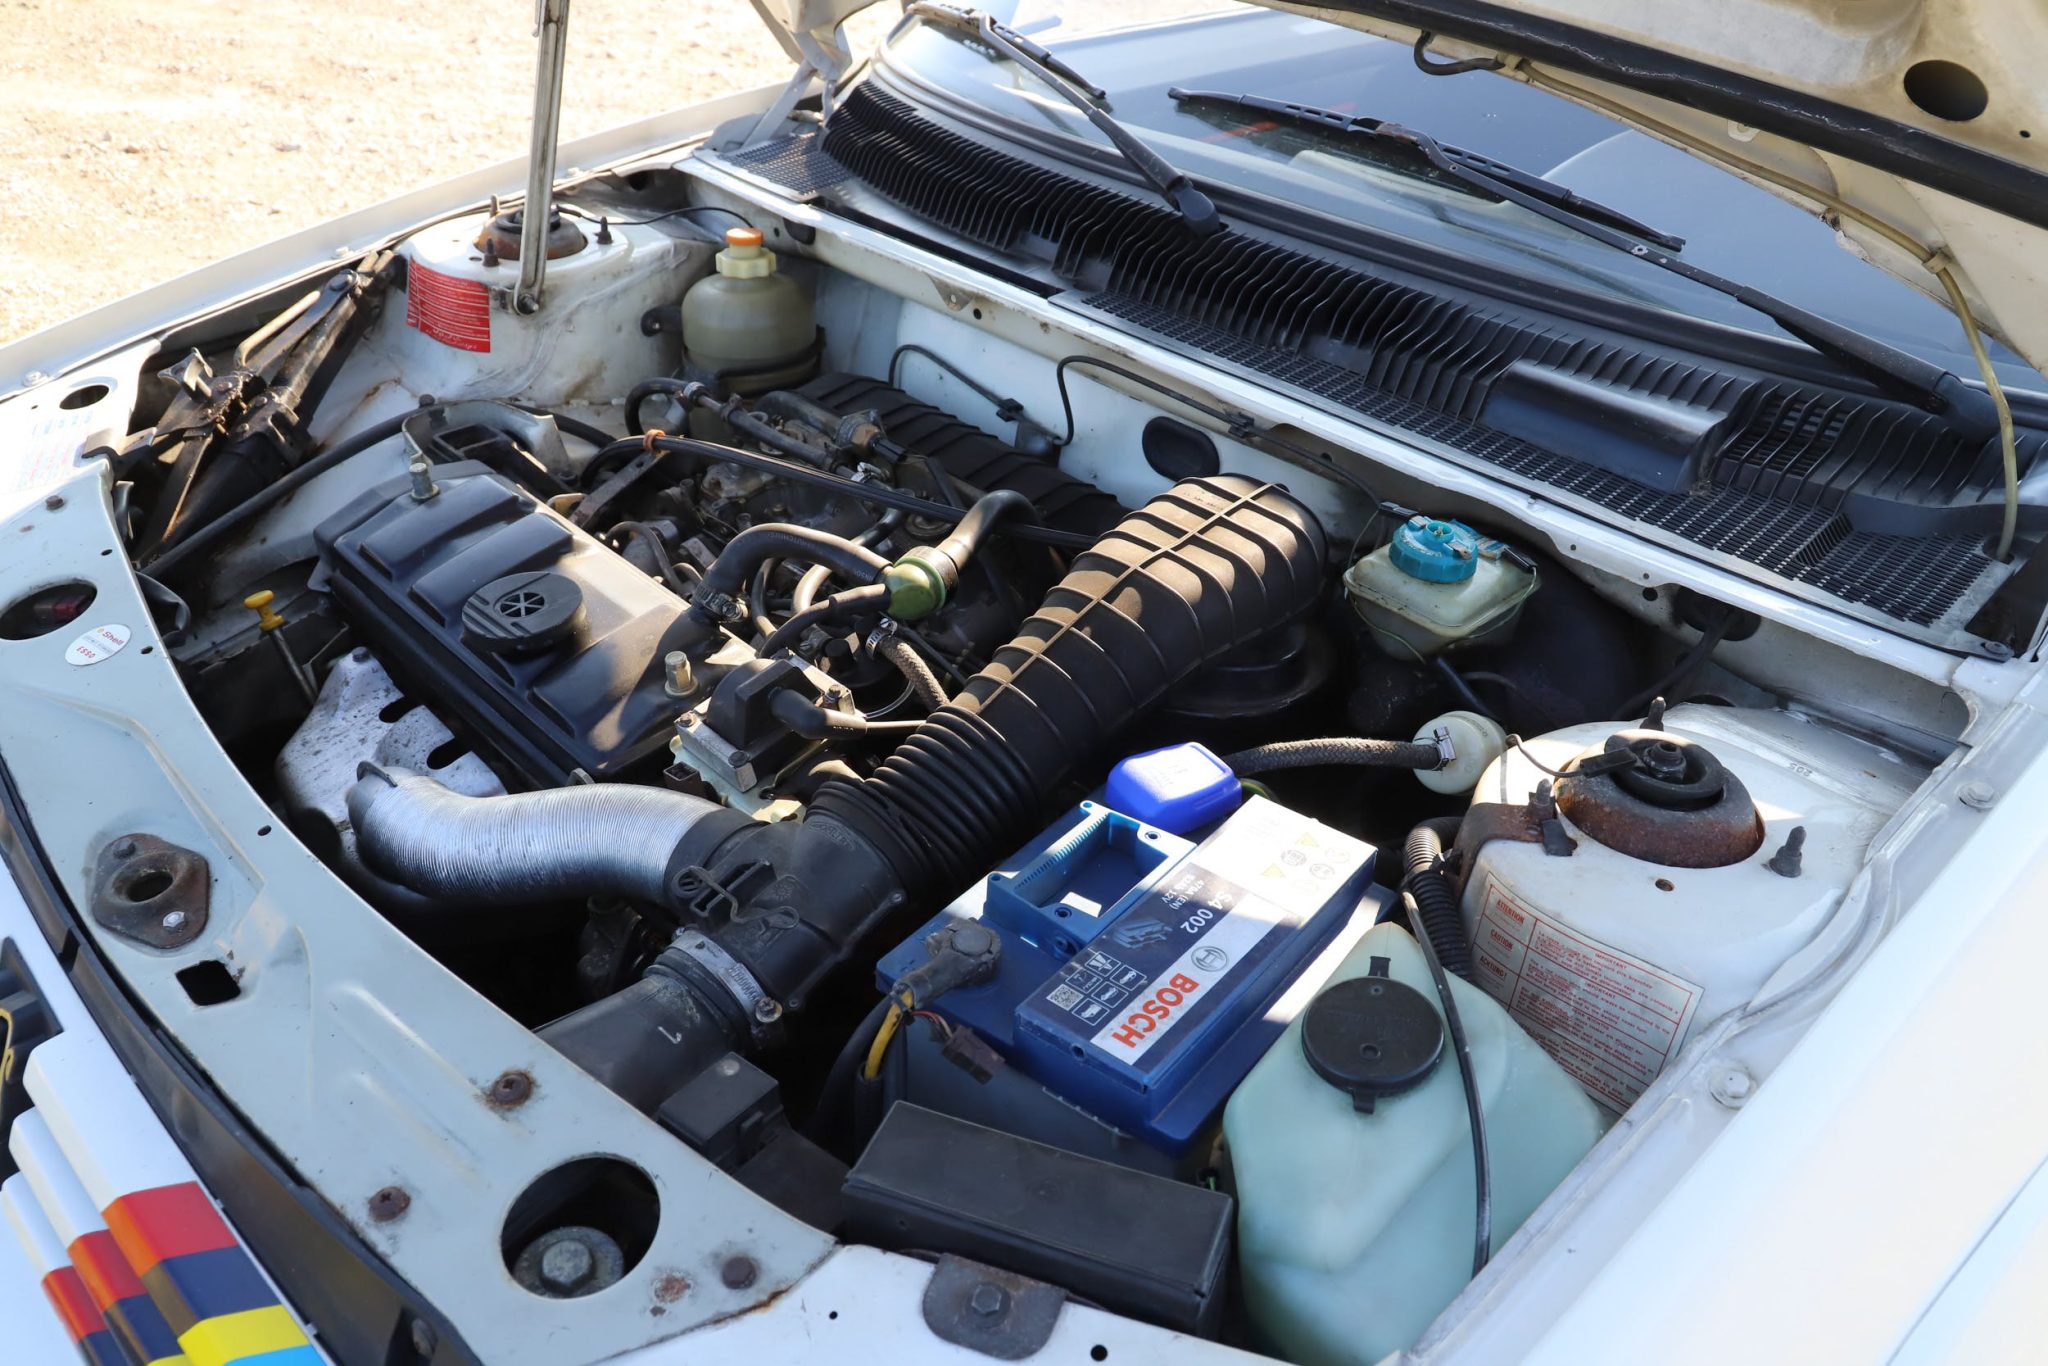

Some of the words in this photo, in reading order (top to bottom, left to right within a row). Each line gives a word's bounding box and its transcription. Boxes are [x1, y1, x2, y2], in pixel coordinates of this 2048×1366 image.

[102, 631, 125, 646] Shell
[1160, 889, 1176, 903] 12V
[1169, 894, 1188, 910] (EN)
[1208, 891, 1232, 910] S4
[1180, 908, 1213, 934] 002
[1496, 899, 1524, 924] ATTENTION
[1490, 929, 1513, 950] CAUTION
[1111, 972, 1200, 1049] BOSCH
